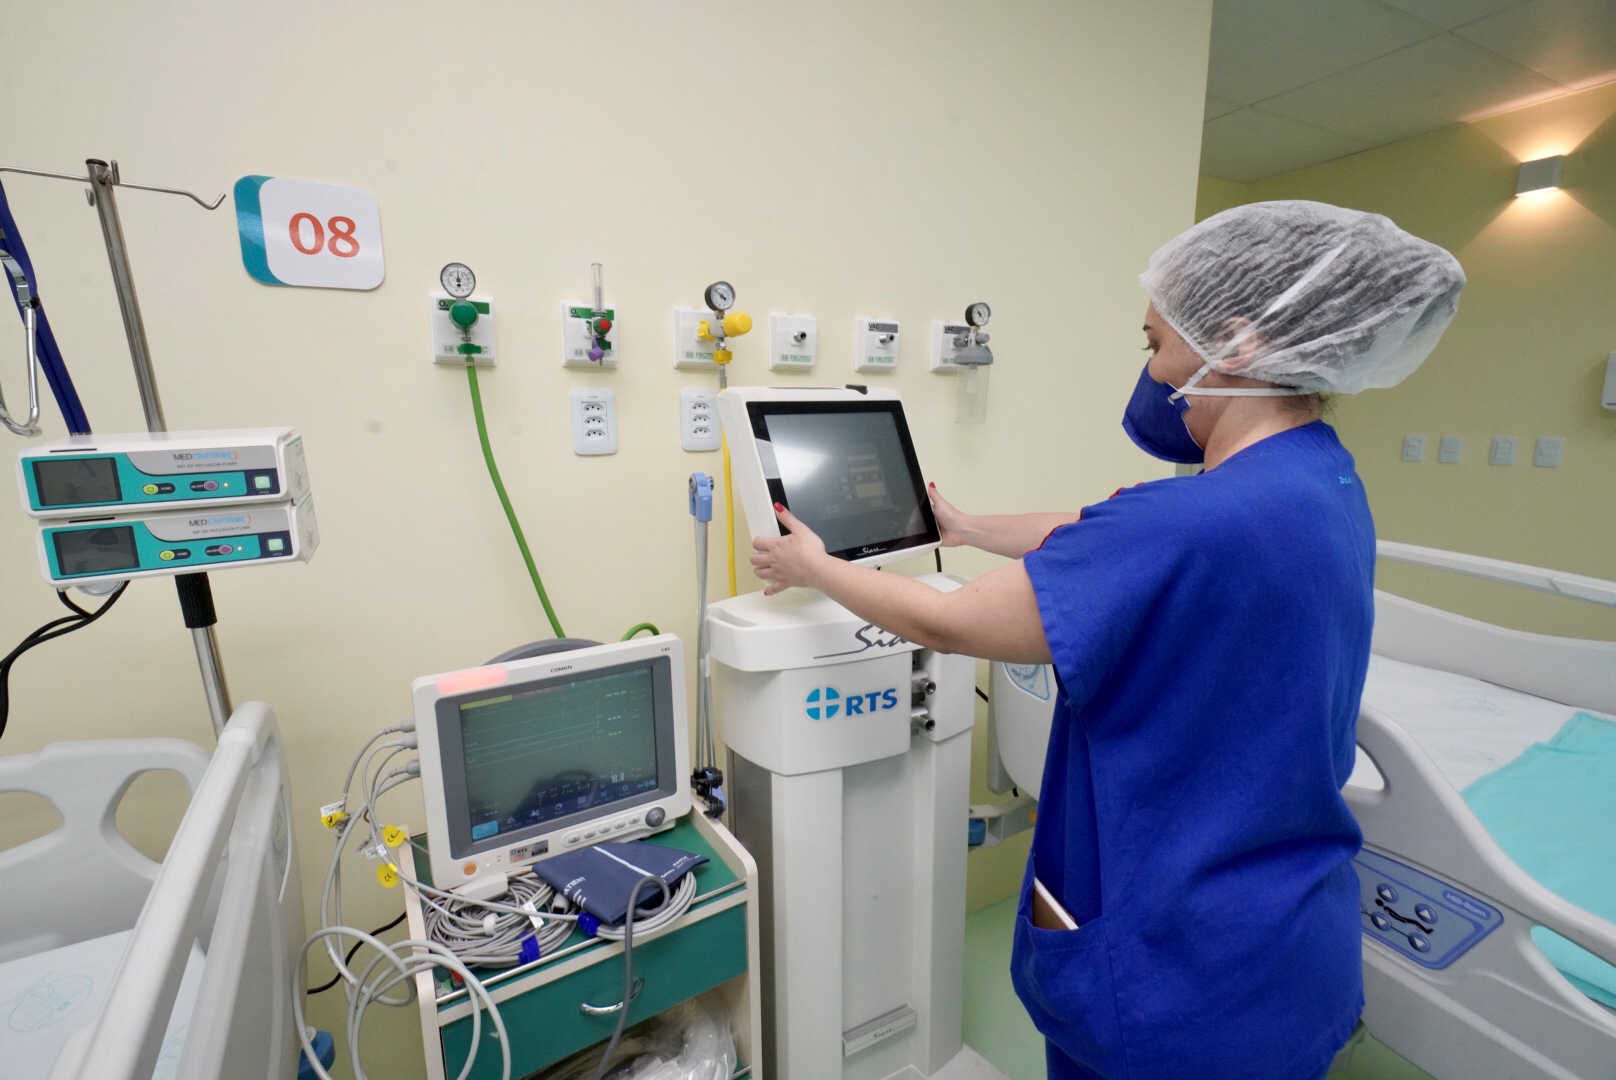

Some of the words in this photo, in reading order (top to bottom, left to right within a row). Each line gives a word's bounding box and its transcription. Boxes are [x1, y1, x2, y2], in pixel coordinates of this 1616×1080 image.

[289, 212, 360, 258] 08
[695, 352, 714, 360] PROT
[790, 354, 812, 362] PROTEC
[846, 688, 898, 716] RTS
[563, 876, 586, 896] ATIENT
